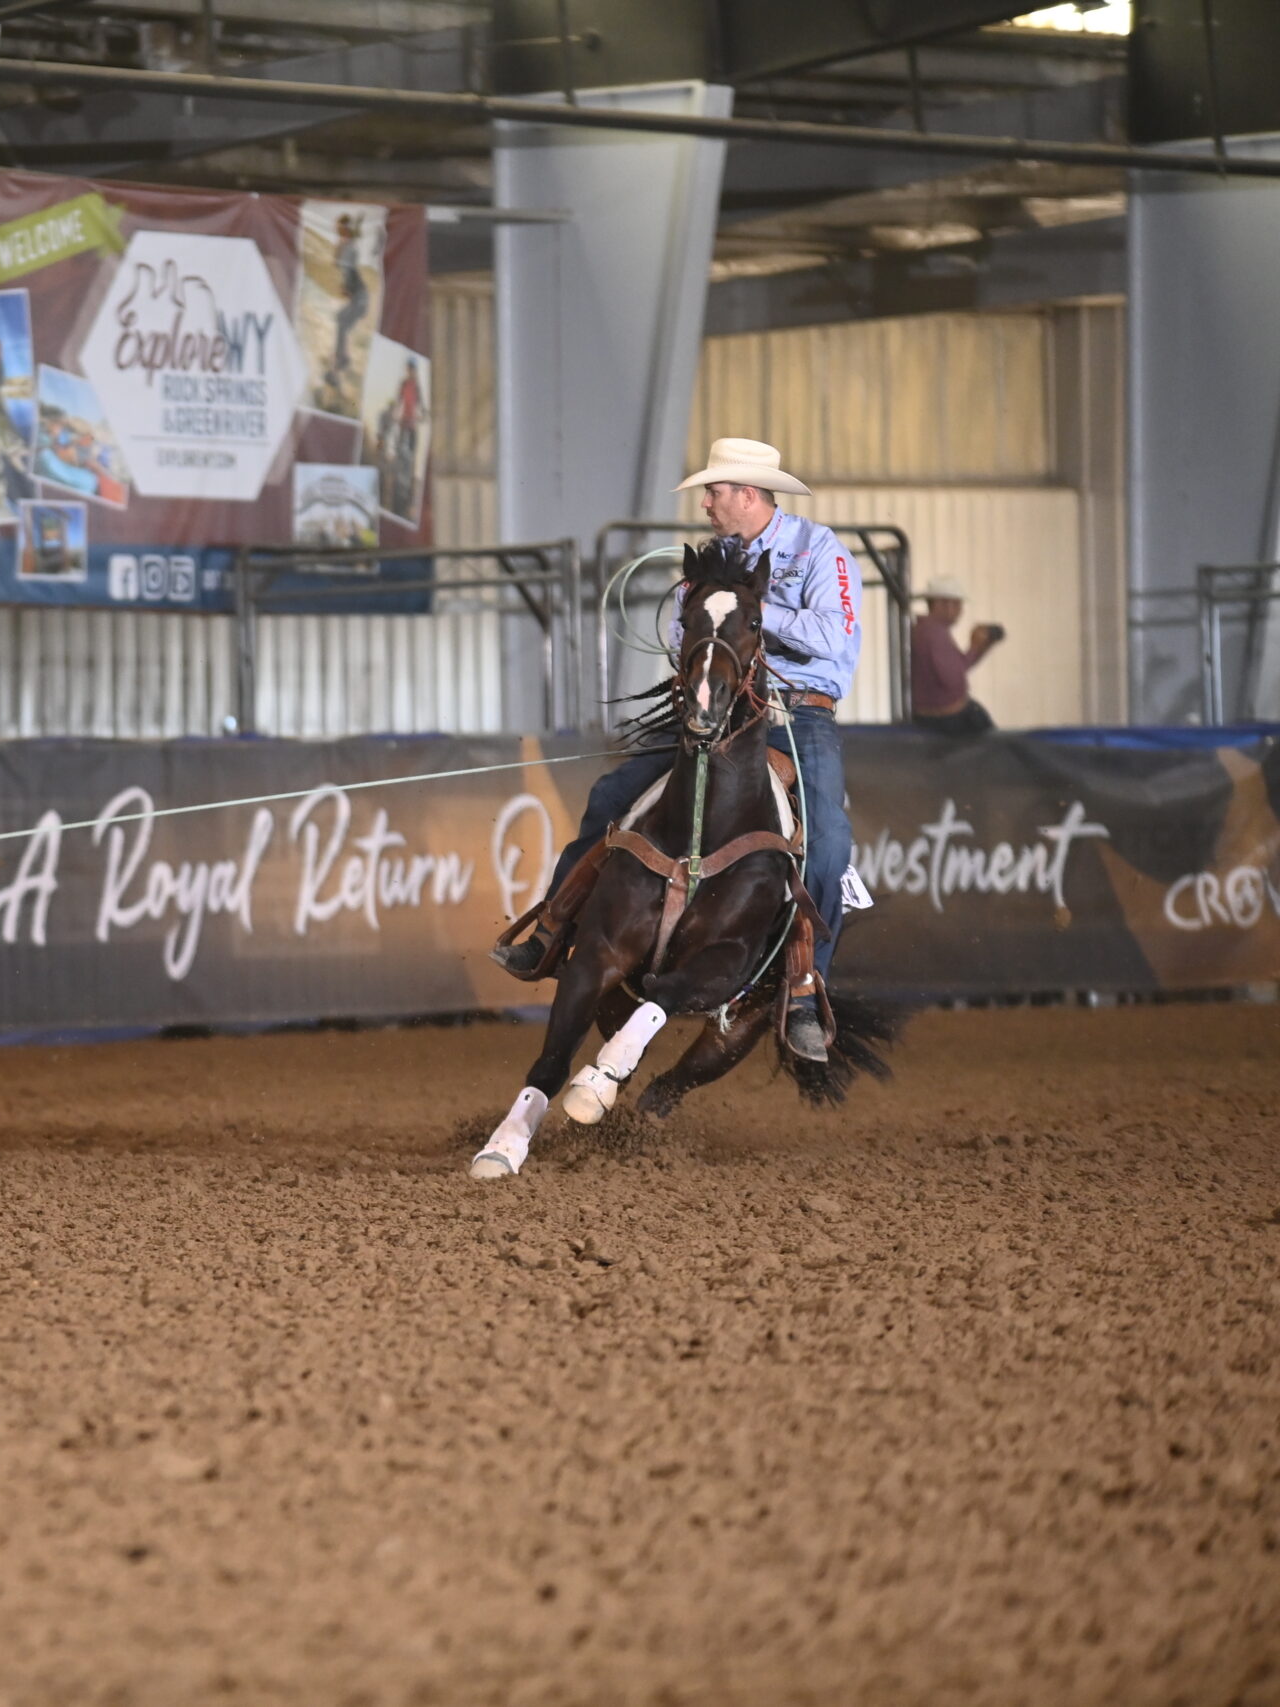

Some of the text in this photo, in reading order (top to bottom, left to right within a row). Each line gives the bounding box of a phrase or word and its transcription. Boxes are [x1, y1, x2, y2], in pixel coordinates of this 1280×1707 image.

[835, 556, 855, 635] CINCH
[92, 786, 274, 981] Royal
[290, 783, 475, 936] Return
